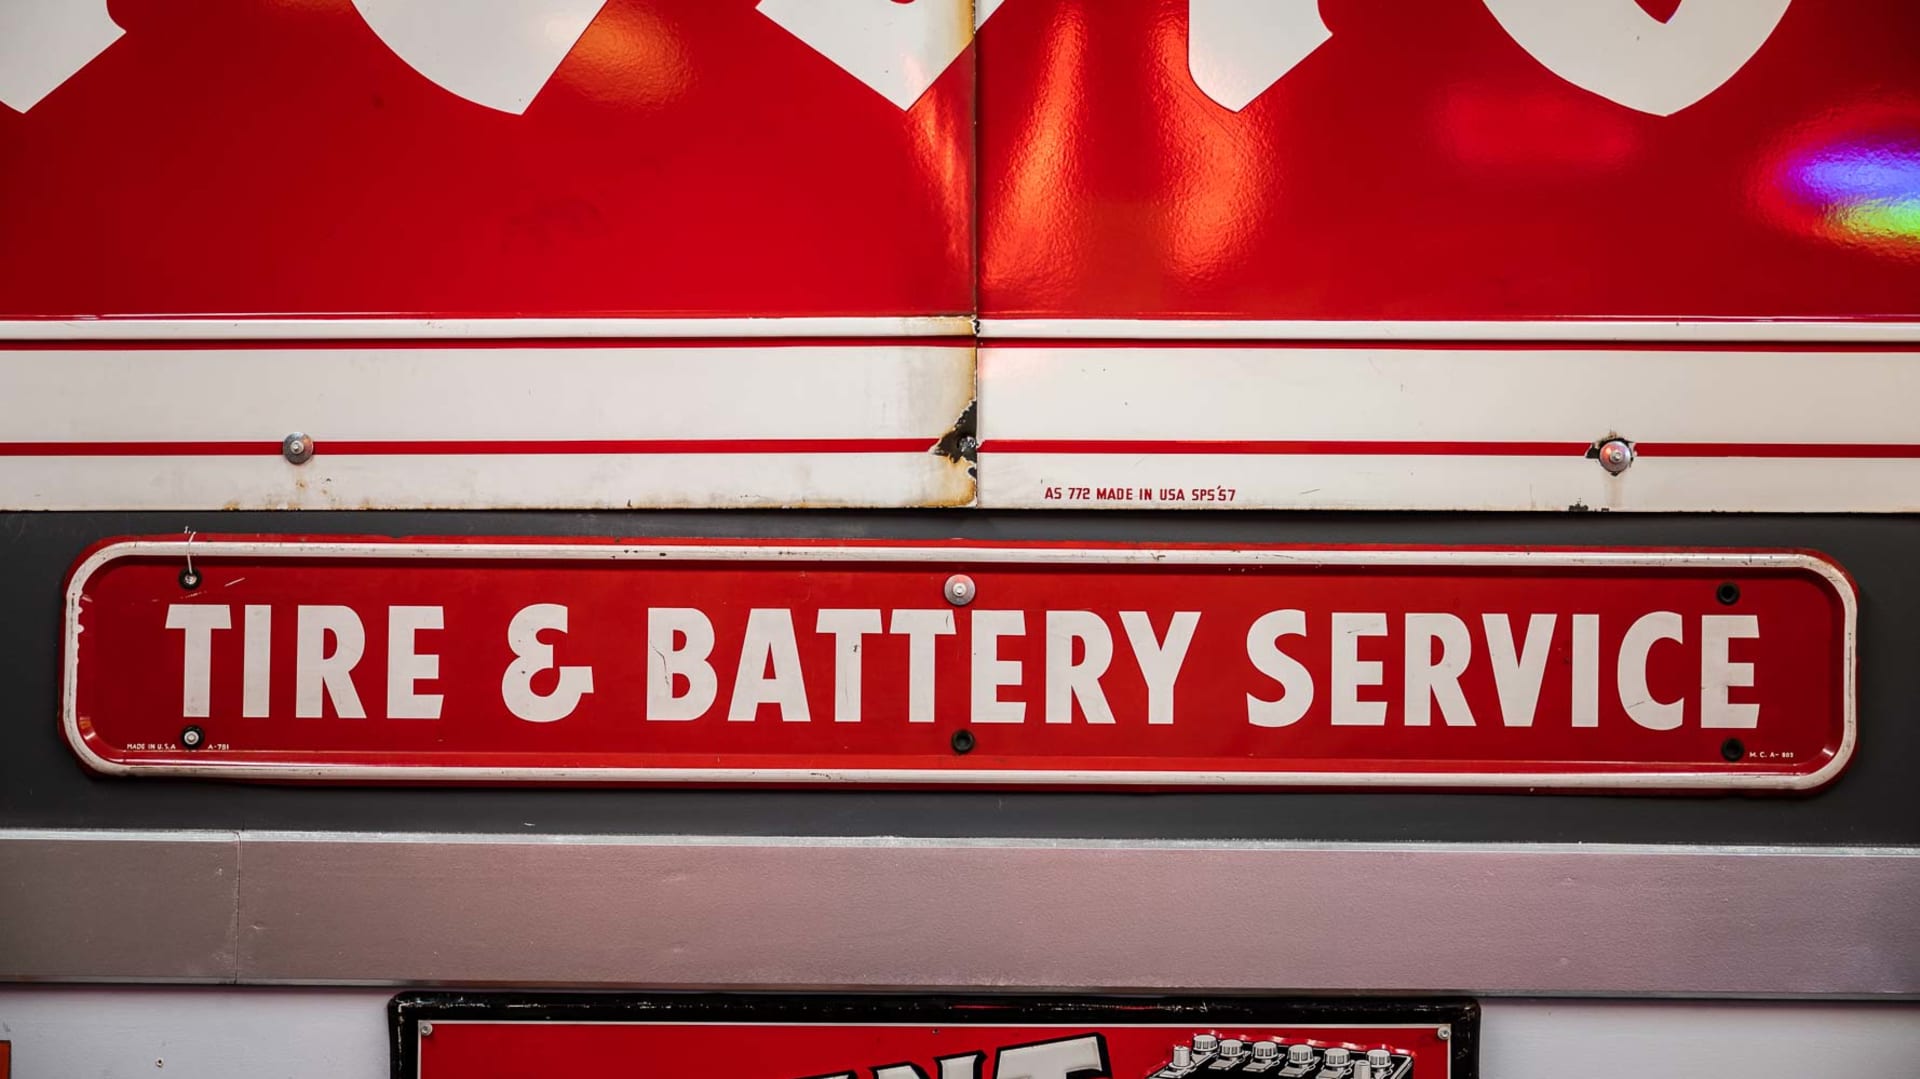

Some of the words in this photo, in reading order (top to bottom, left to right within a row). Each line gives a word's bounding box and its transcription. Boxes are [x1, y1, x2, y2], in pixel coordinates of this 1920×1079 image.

[1045, 487, 1062, 500] AS
[1068, 487, 1090, 500] 772
[1096, 487, 1133, 500] MADE
[1139, 488, 1153, 501] IN
[1159, 488, 1185, 501] USA
[166, 604, 444, 719] TIRE
[502, 604, 593, 722] &
[647, 608, 1201, 726] BATTERY
[1247, 609, 1760, 730] SERVICE
